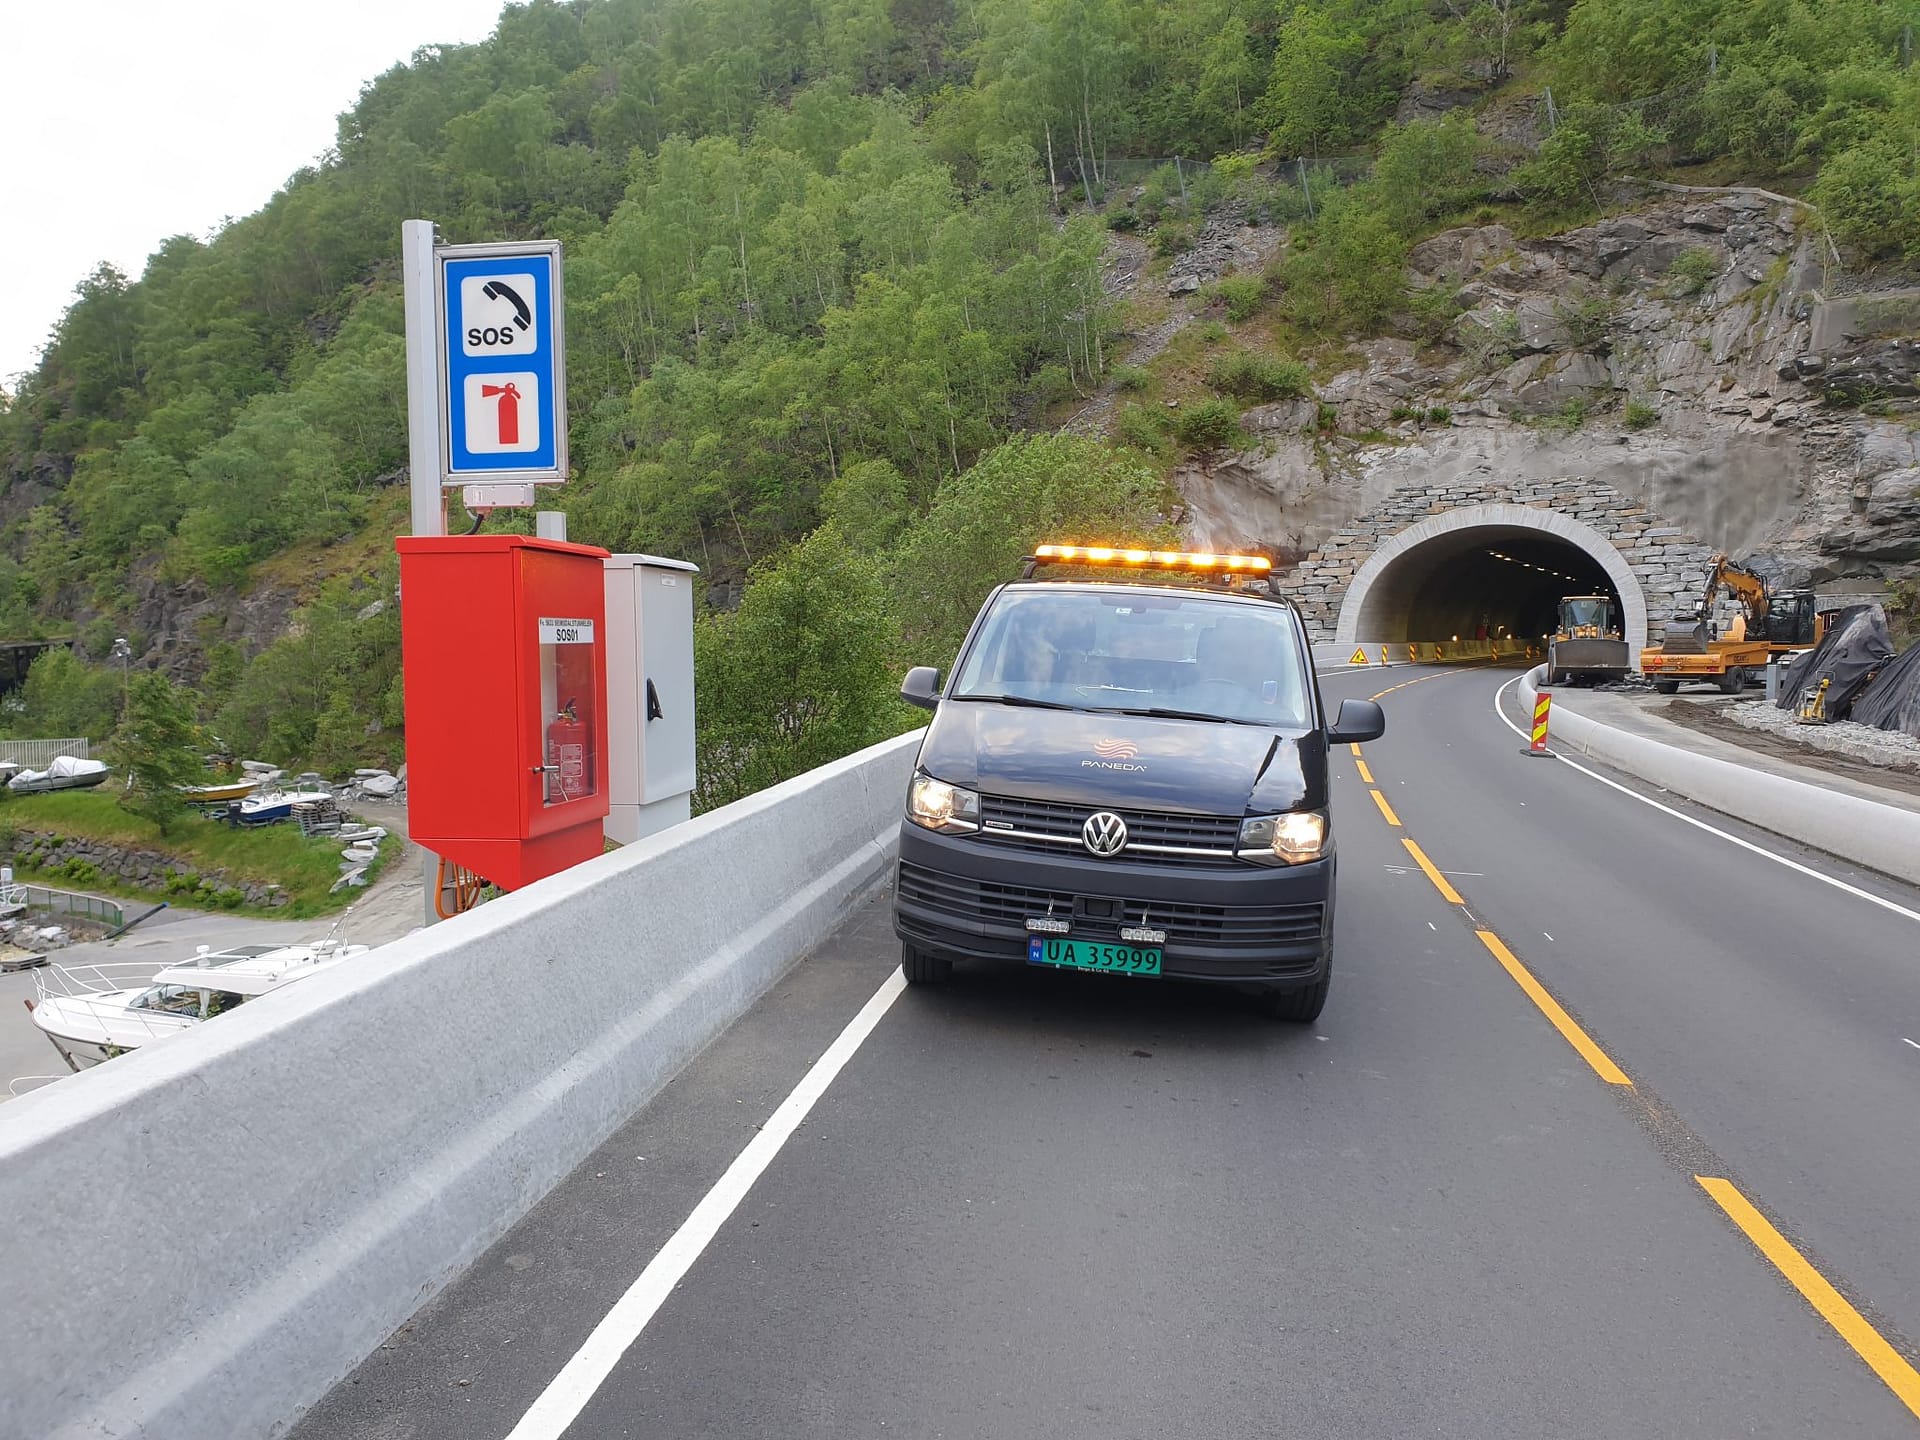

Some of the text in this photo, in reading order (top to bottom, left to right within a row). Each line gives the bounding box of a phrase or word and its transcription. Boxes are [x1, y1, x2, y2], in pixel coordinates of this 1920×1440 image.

[467, 326, 514, 347] SOS
[556, 628, 579, 642] SOS01
[1081, 760, 1145, 772] PANEDA
[1047, 941, 1157, 970] UA 35999
